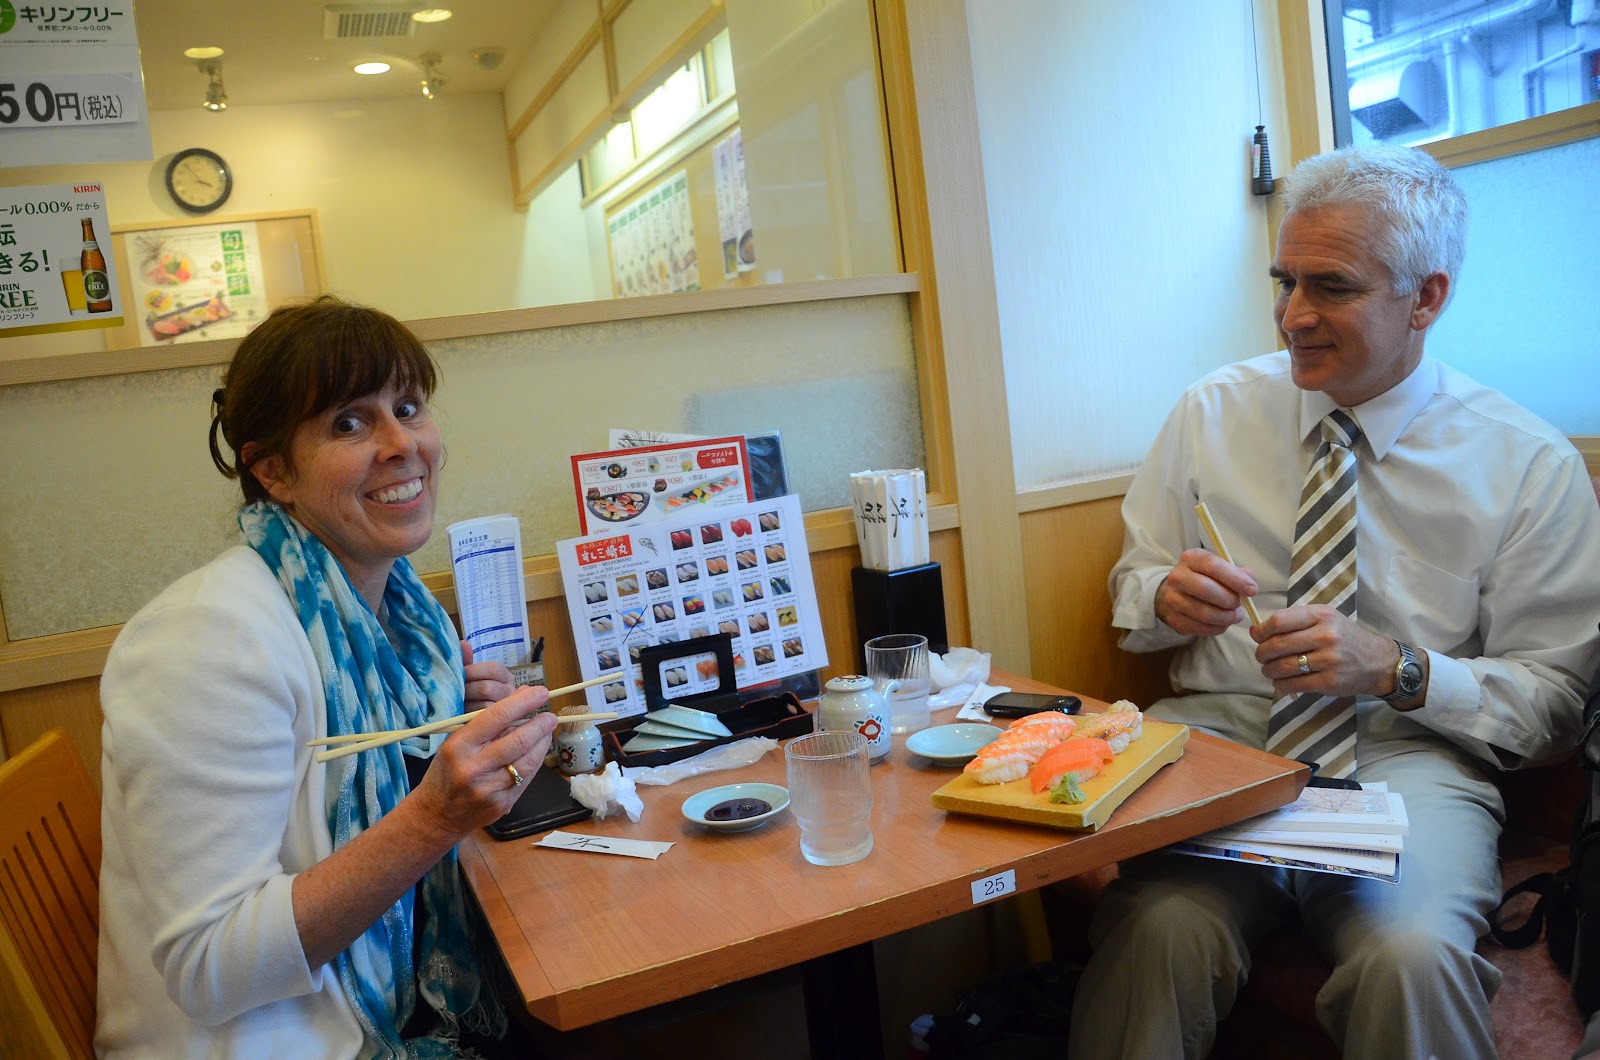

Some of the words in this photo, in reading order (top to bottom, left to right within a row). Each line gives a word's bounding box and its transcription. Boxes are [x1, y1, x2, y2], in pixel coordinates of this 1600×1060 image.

[20, 6, 123, 22] キリンフリー
[74, 185, 101, 193] KIRIN
[984, 876, 1005, 896] 25
